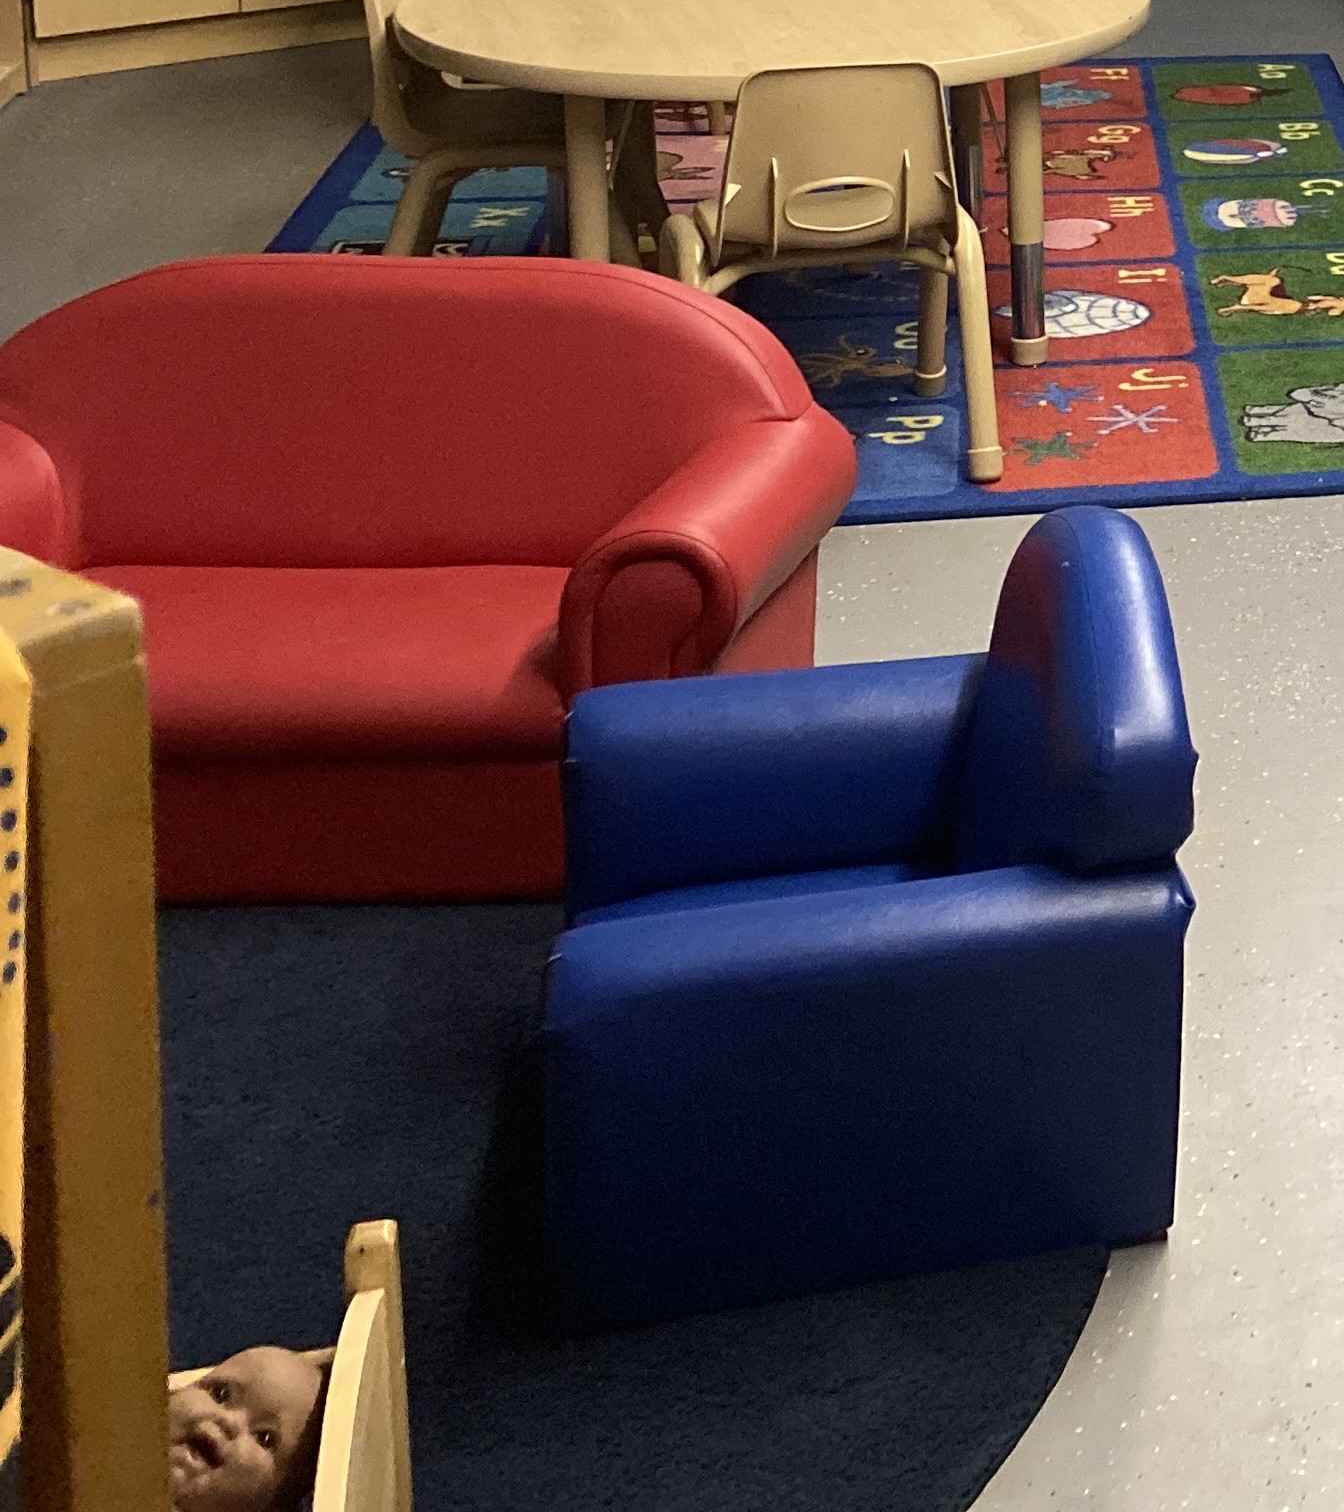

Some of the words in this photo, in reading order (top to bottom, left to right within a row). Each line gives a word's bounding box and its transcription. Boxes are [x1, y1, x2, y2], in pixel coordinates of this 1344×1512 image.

[1089, 67, 1131, 81] Ff
[1257, 63, 1297, 80] Aa
[1087, 124, 1142, 145] Gg
[1278, 121, 1322, 141] Bb
[1299, 178, 1344, 197] Cc
[1106, 195, 1155, 218] Hh
[1117, 267, 1169, 284] Ii
[1118, 367, 1190, 391] Jj
[868, 414, 946, 445] Pp
